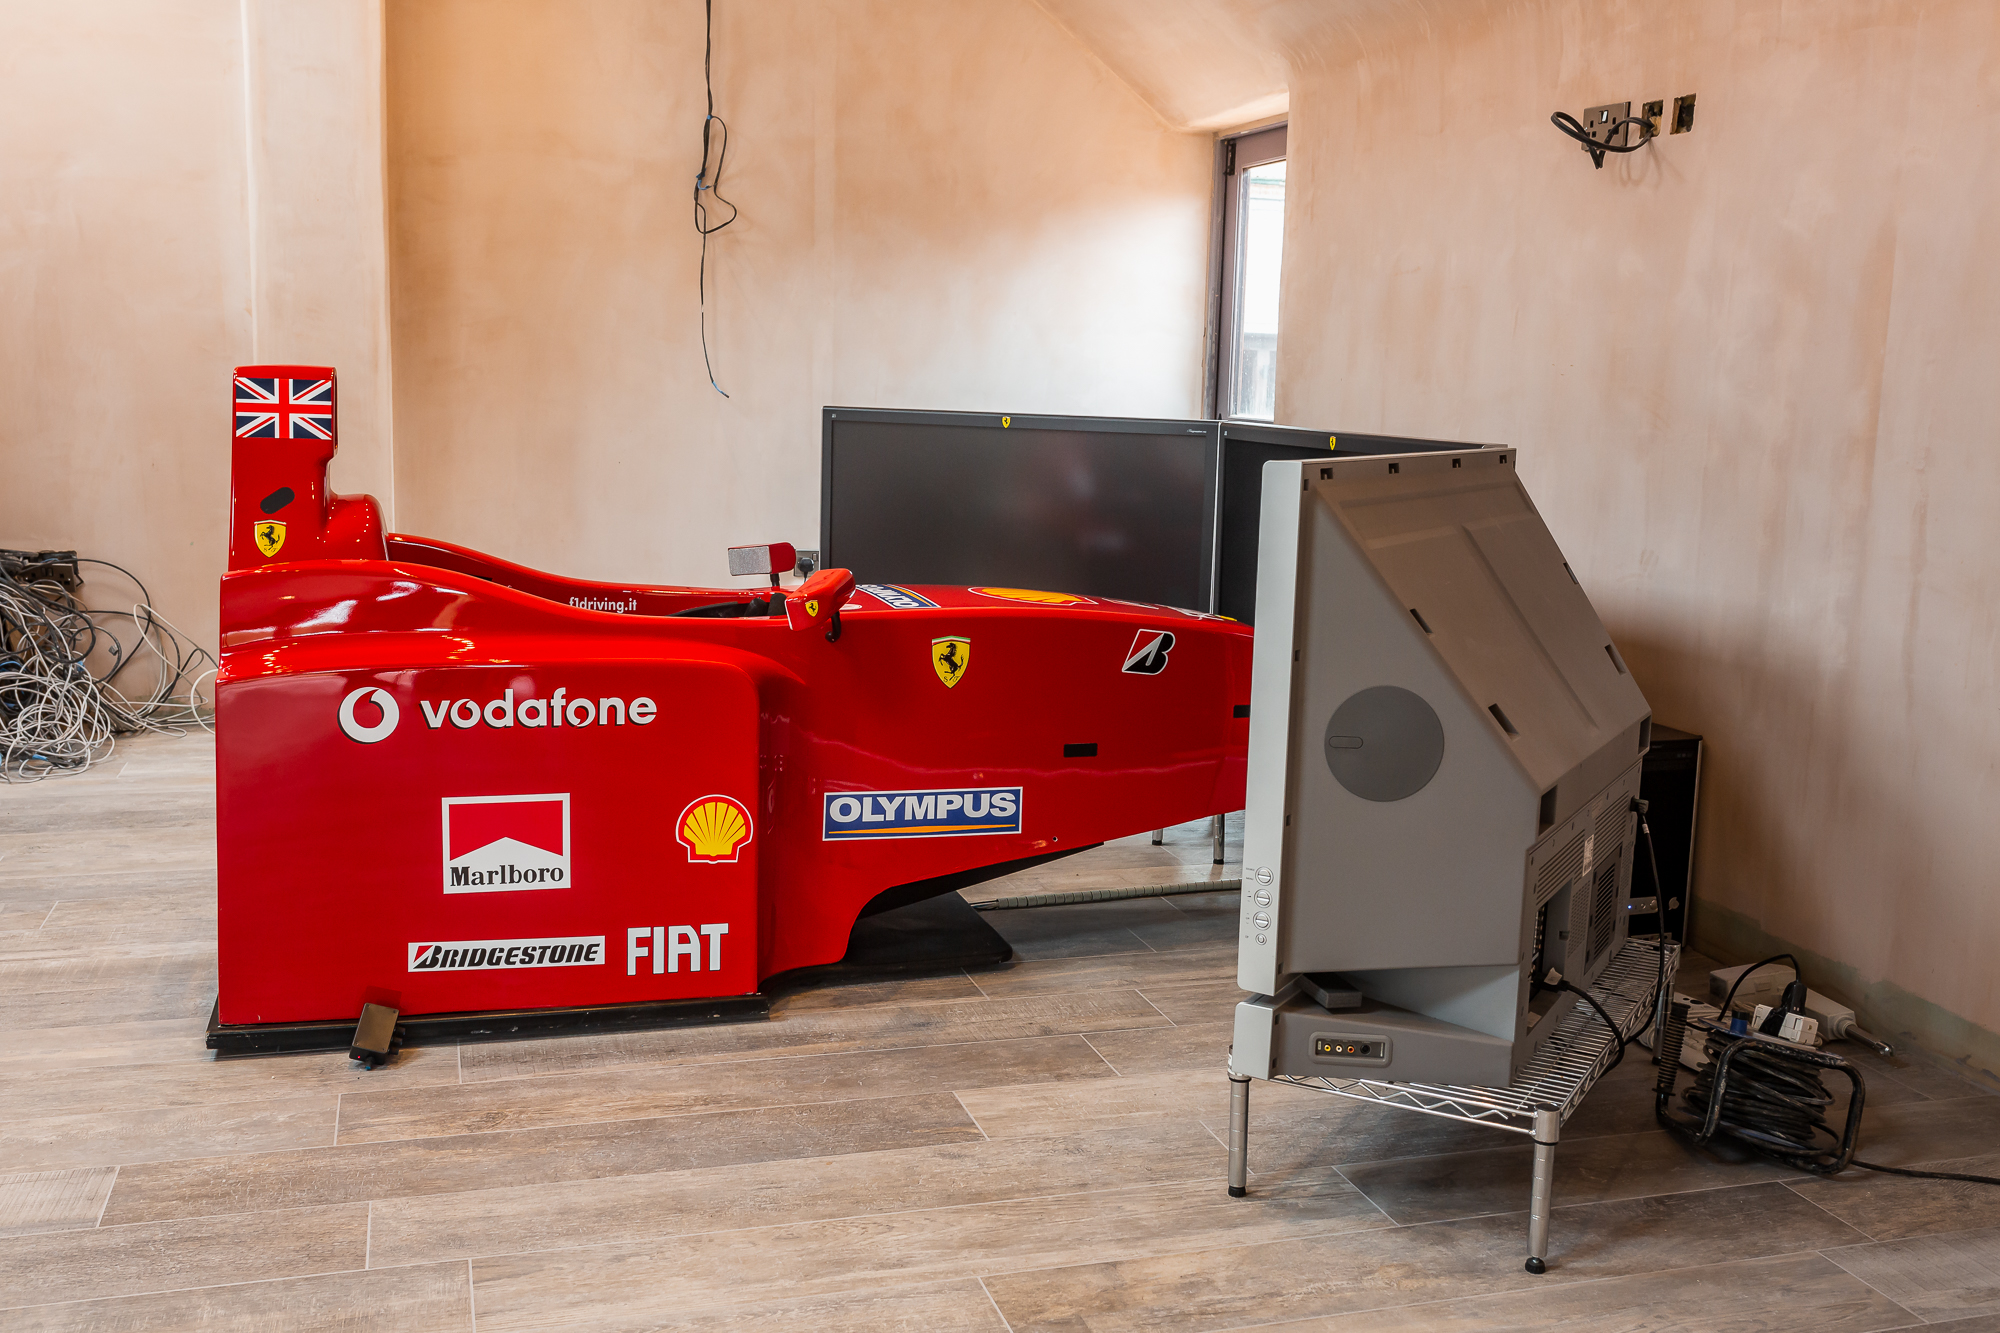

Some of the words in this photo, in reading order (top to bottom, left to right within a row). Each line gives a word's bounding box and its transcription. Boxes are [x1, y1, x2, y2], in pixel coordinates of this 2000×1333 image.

[568, 596, 637, 614] f1driving.it
[420, 687, 657, 729] vodafone
[829, 792, 1017, 823] OLYMPUS
[449, 864, 564, 887] Marlboro
[412, 942, 601, 970] BRIDGESTONE
[627, 922, 729, 976] FIAT
